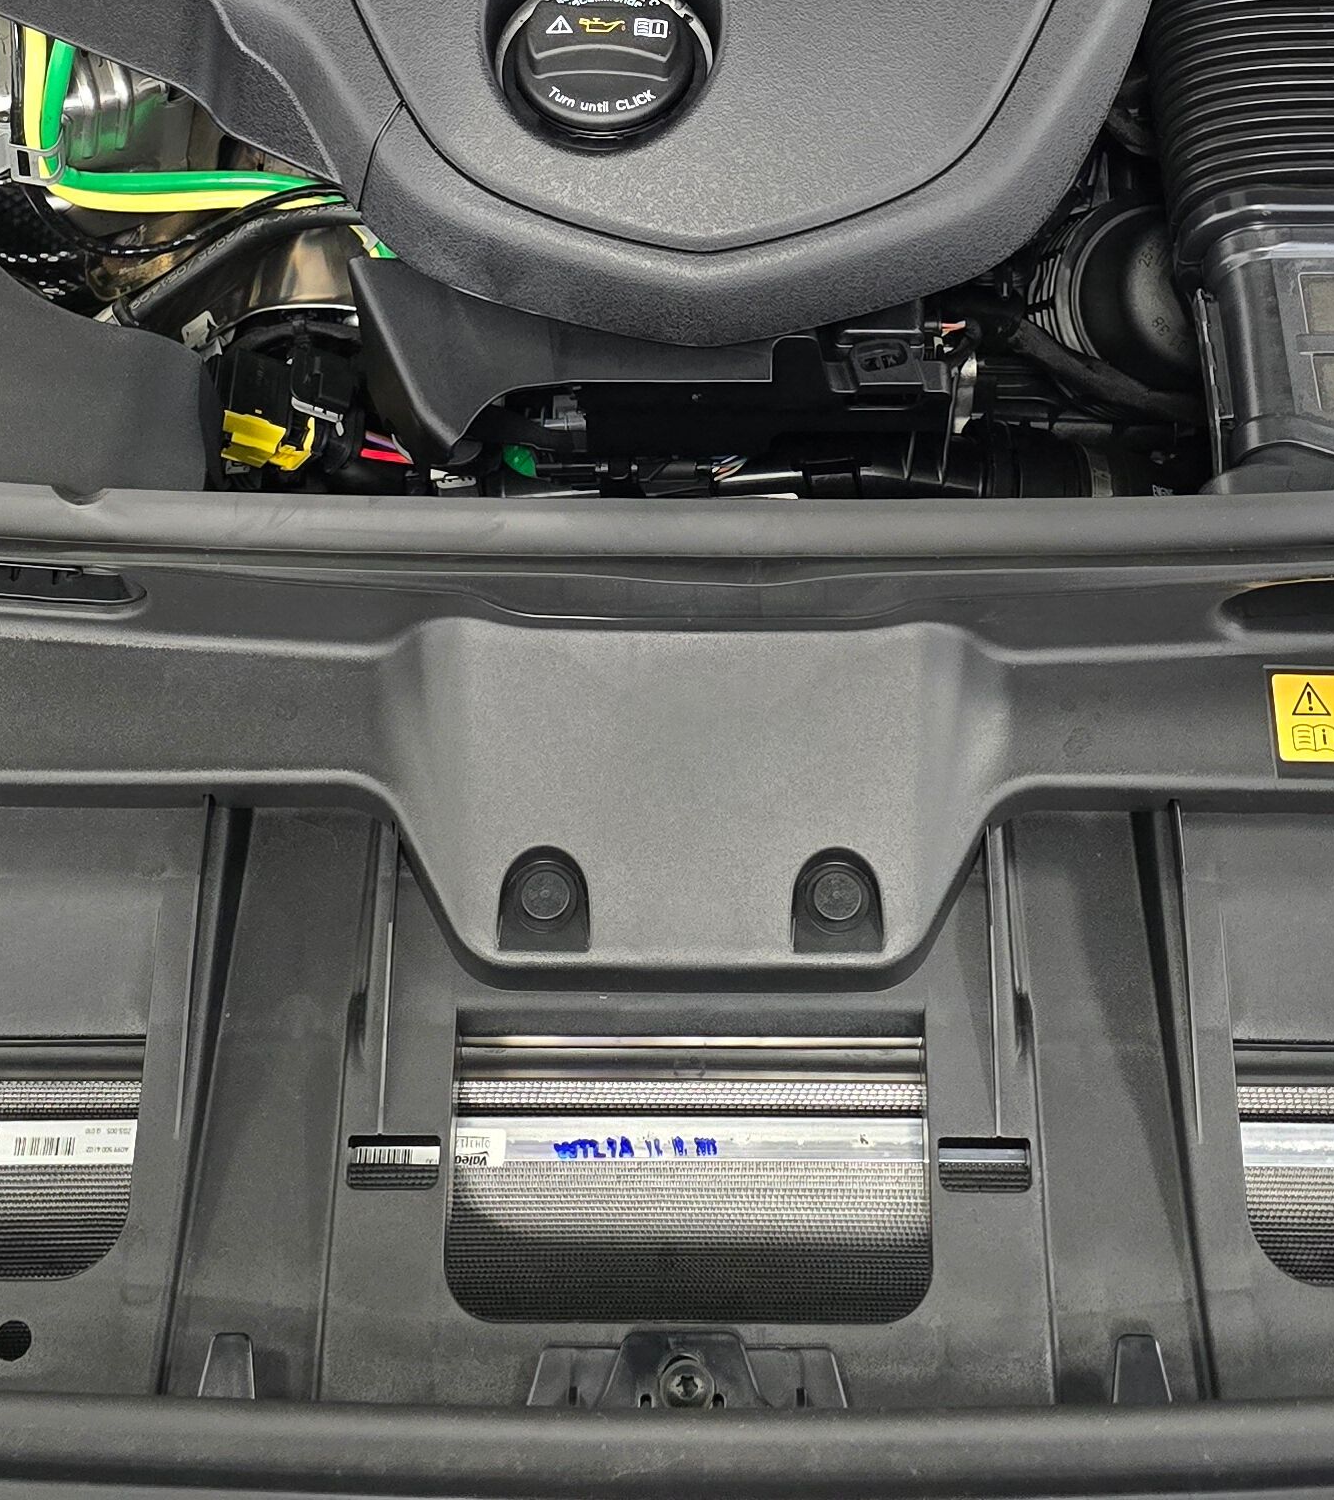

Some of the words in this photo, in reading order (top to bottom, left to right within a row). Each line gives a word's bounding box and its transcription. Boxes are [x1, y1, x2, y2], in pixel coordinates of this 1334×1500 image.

[547, 86, 576, 108] Turn
[580, 101, 609, 113] until
[615, 89, 657, 111] CLICK
[454, 1152, 488, 1166] Valeo
